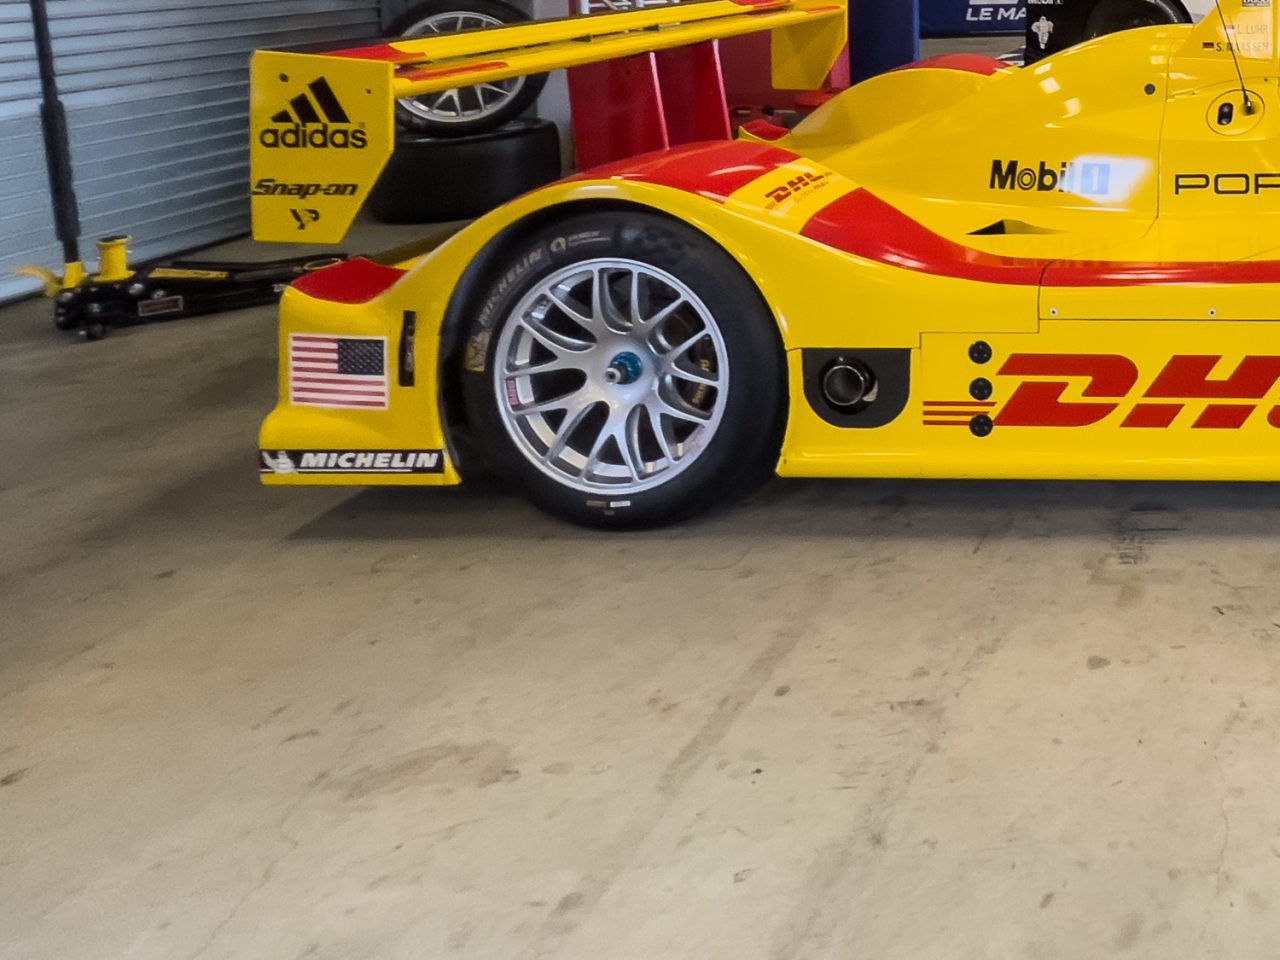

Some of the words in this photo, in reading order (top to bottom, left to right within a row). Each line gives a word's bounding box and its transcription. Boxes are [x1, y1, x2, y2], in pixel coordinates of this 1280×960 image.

[966, 8, 993, 21] LE
[260, 122, 368, 149] adidas
[252, 178, 359, 200] Snap-on
[765, 171, 825, 204] DHL
[300, 452, 438, 468] MICHELIN
